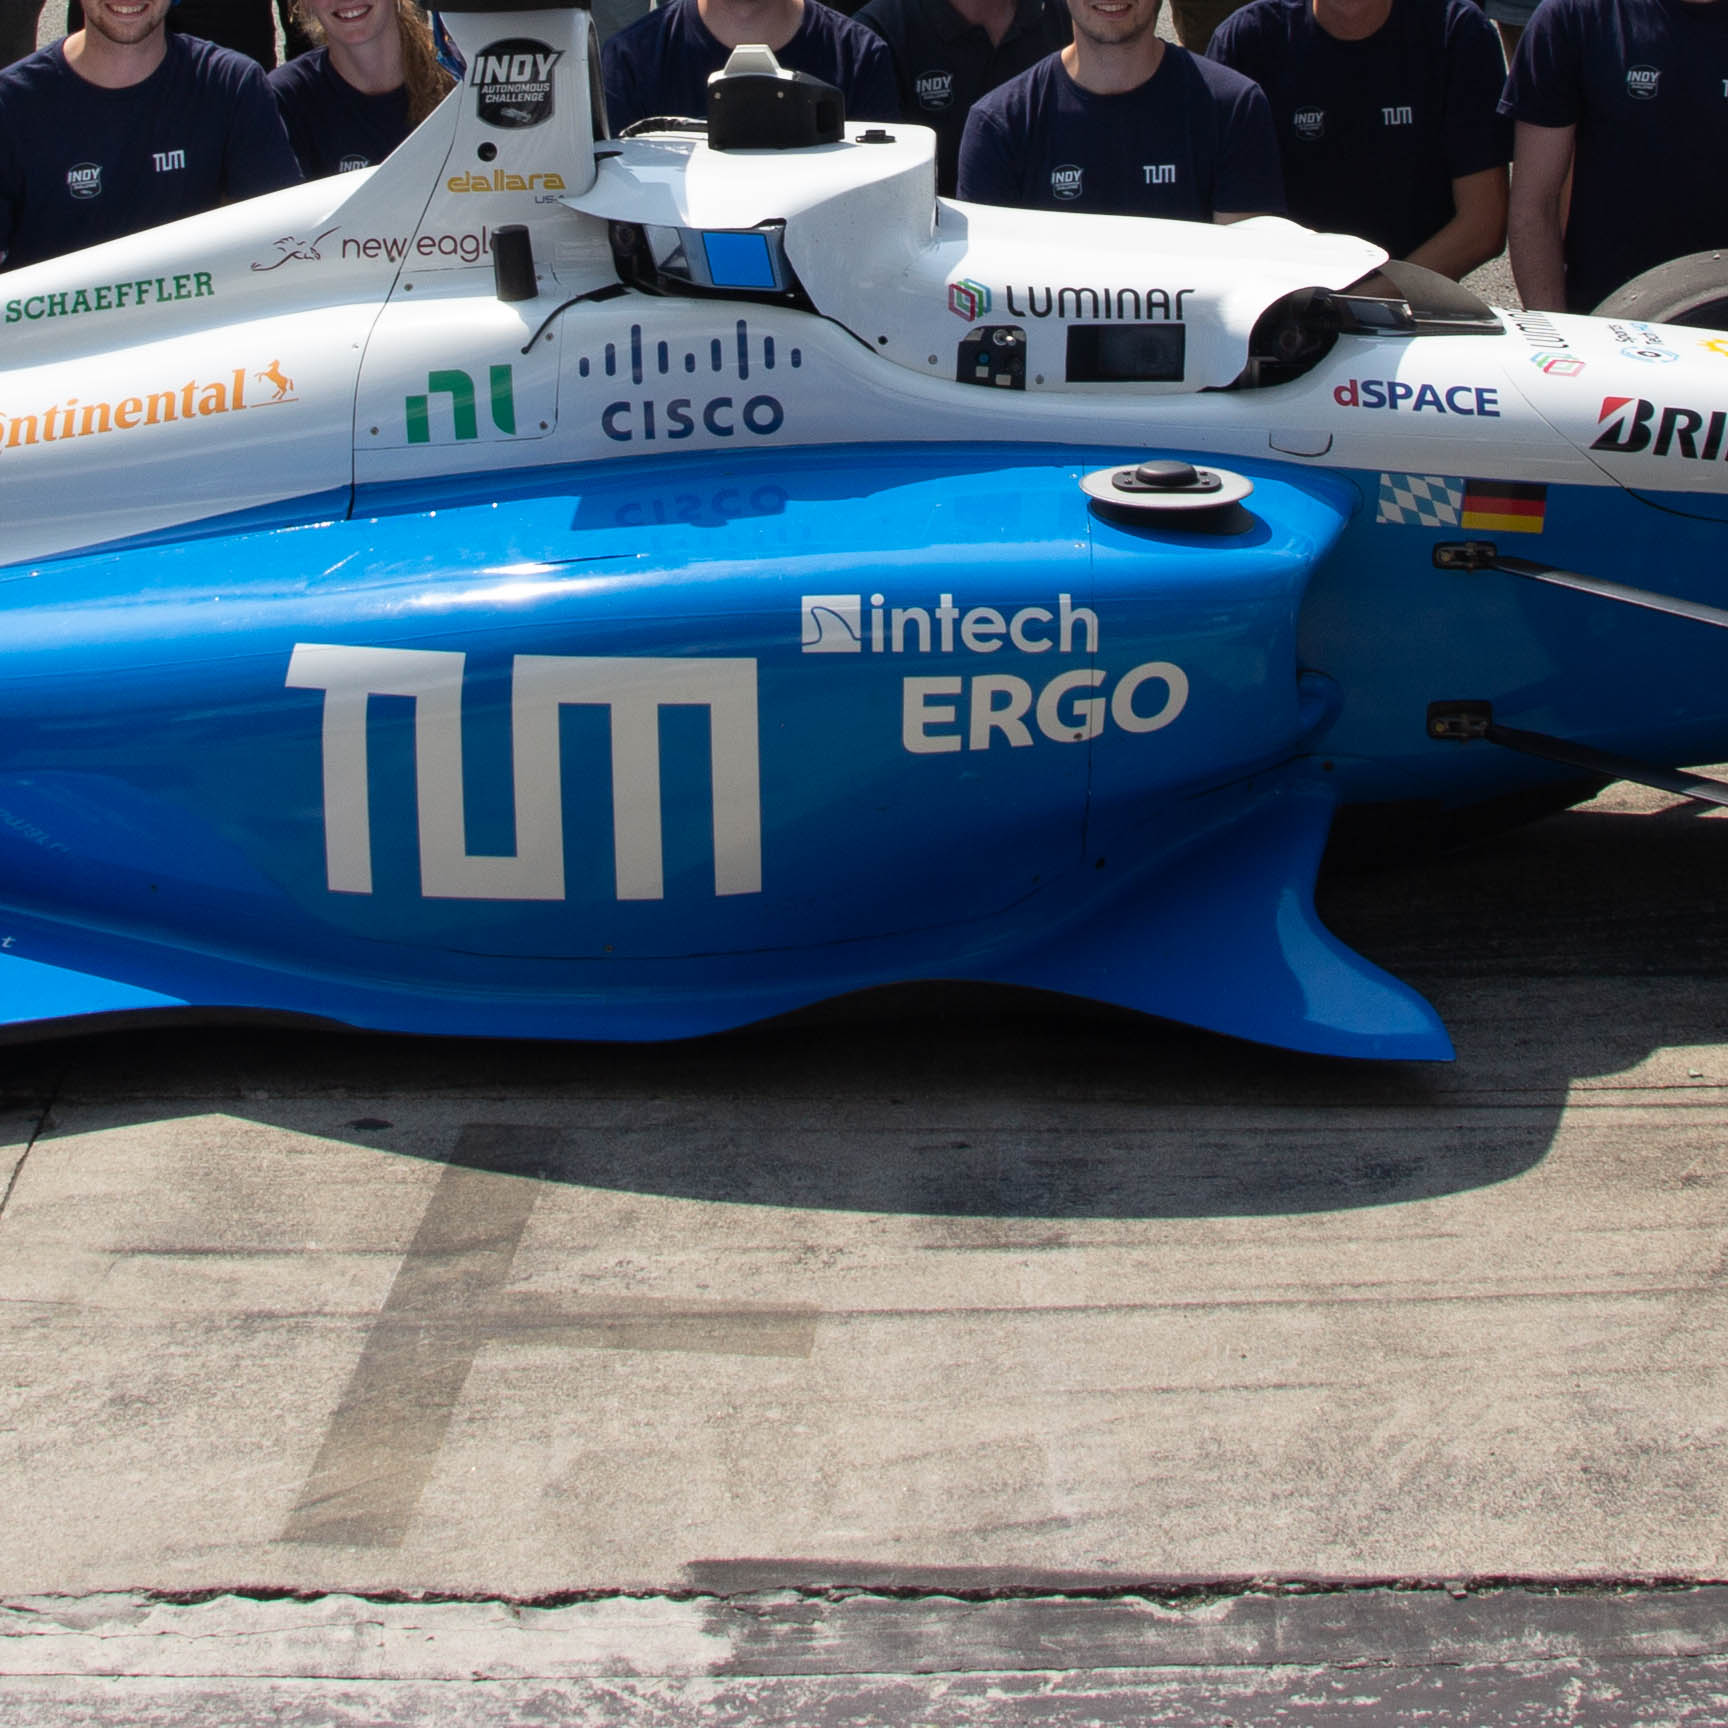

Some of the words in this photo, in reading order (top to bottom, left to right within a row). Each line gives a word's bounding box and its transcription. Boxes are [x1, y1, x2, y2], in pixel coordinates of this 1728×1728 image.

[473, 54, 559, 84] INDY
[1627, 71, 1660, 83] INDY
[481, 83, 551, 94] AUTONOMOUS
[916, 75, 953, 93] INDY
[485, 92, 545, 104] CHALLENGE
[1293, 112, 1324, 126] INDY
[1382, 106, 1413, 126] TUM
[153, 150, 185, 172] TUM
[340, 160, 368, 172] INDY
[67, 168, 101, 183] INDY
[447, 169, 567, 193] dallara
[1051, 169, 1084, 185] INDY
[1143, 165, 1176, 185] TUM
[341, 236, 408, 260] new
[416, 225, 496, 264] eagl
[5, 272, 215, 323] SCHAEFFLER
[1333, 378, 1501, 417] dSPACE
[601, 394, 785, 442] CISCO
[868, 592, 1100, 653] intech
[901, 661, 1189, 754] ERGO
[284, 642, 762, 901] TUM
